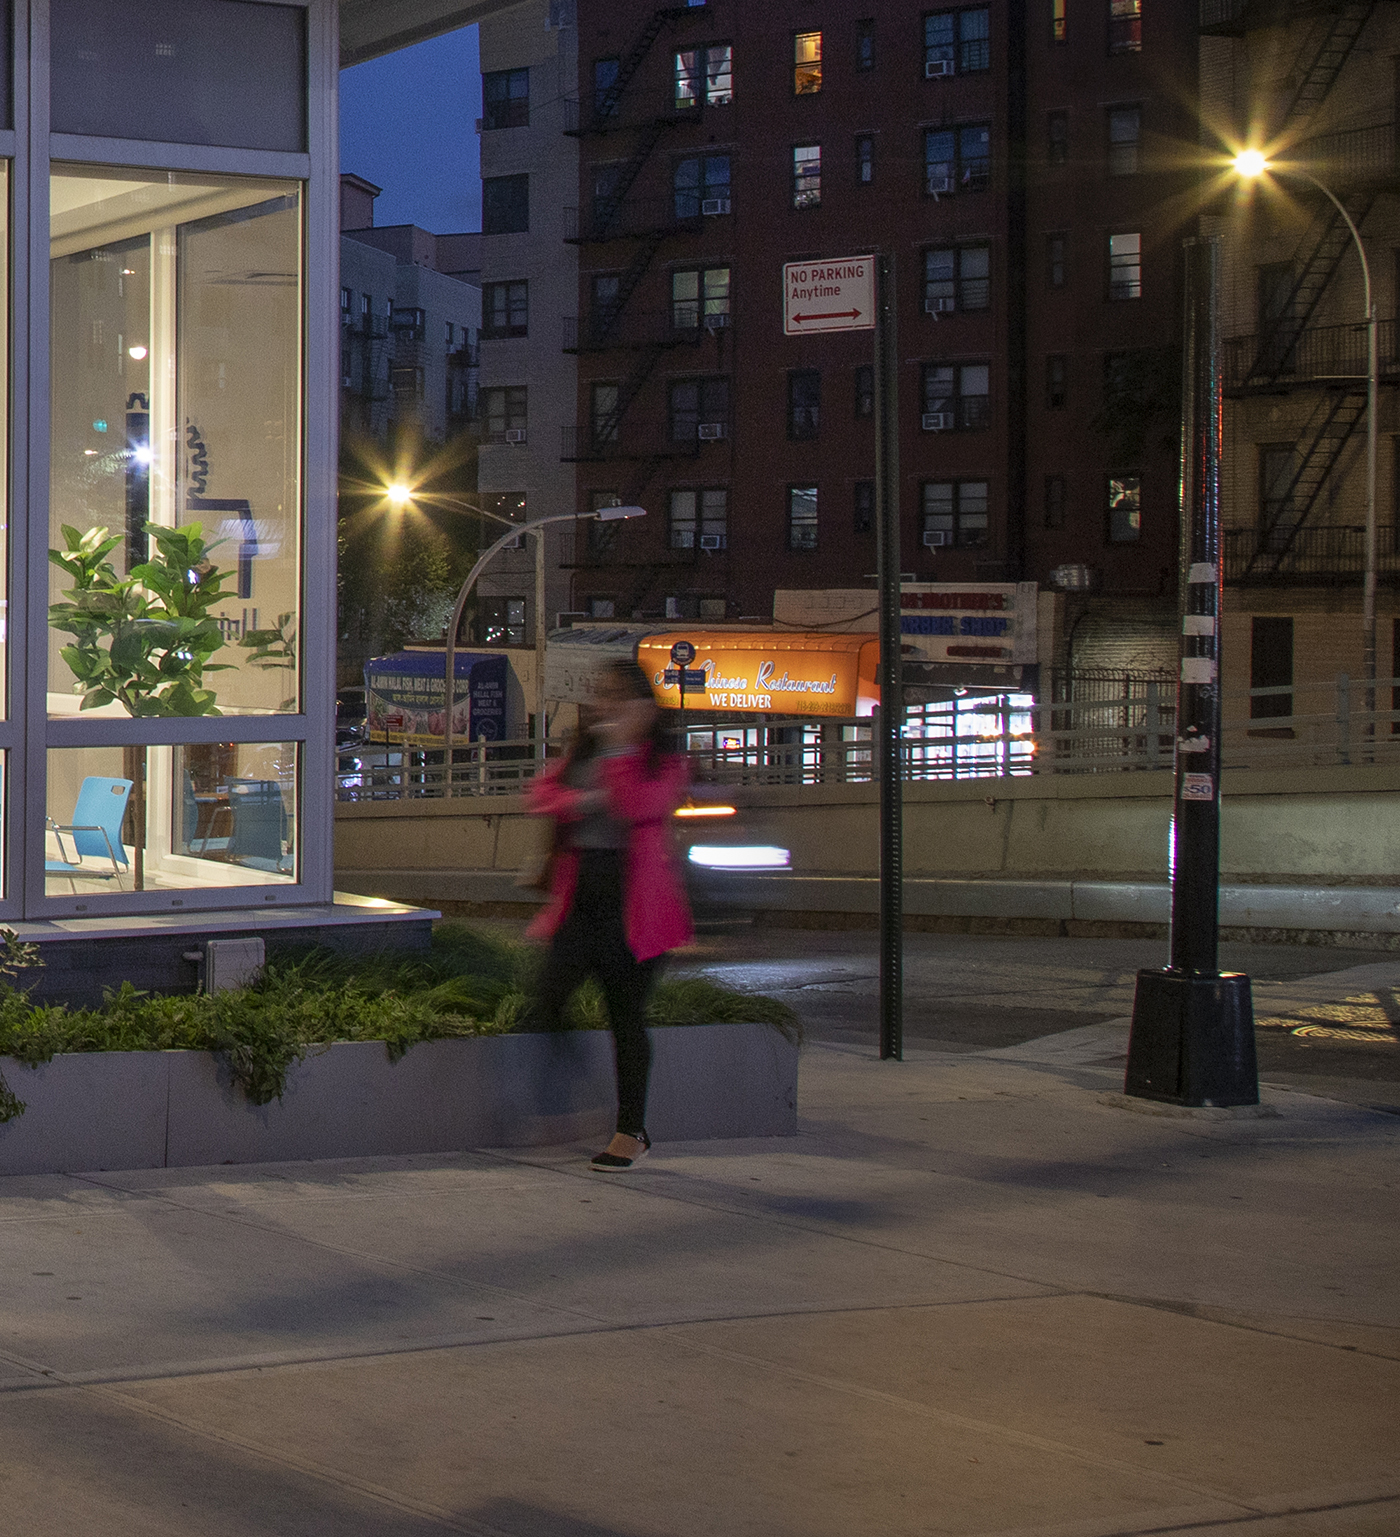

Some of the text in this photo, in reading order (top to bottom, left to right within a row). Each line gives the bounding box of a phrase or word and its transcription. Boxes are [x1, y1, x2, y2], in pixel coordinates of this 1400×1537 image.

[791, 266, 864, 283] NO PARKING
[791, 284, 841, 301] Anytime
[900, 616, 1007, 636] ARBER SHOP
[755, 661, 837, 693] Restaurant
[710, 693, 771, 708] WE DELIVER
